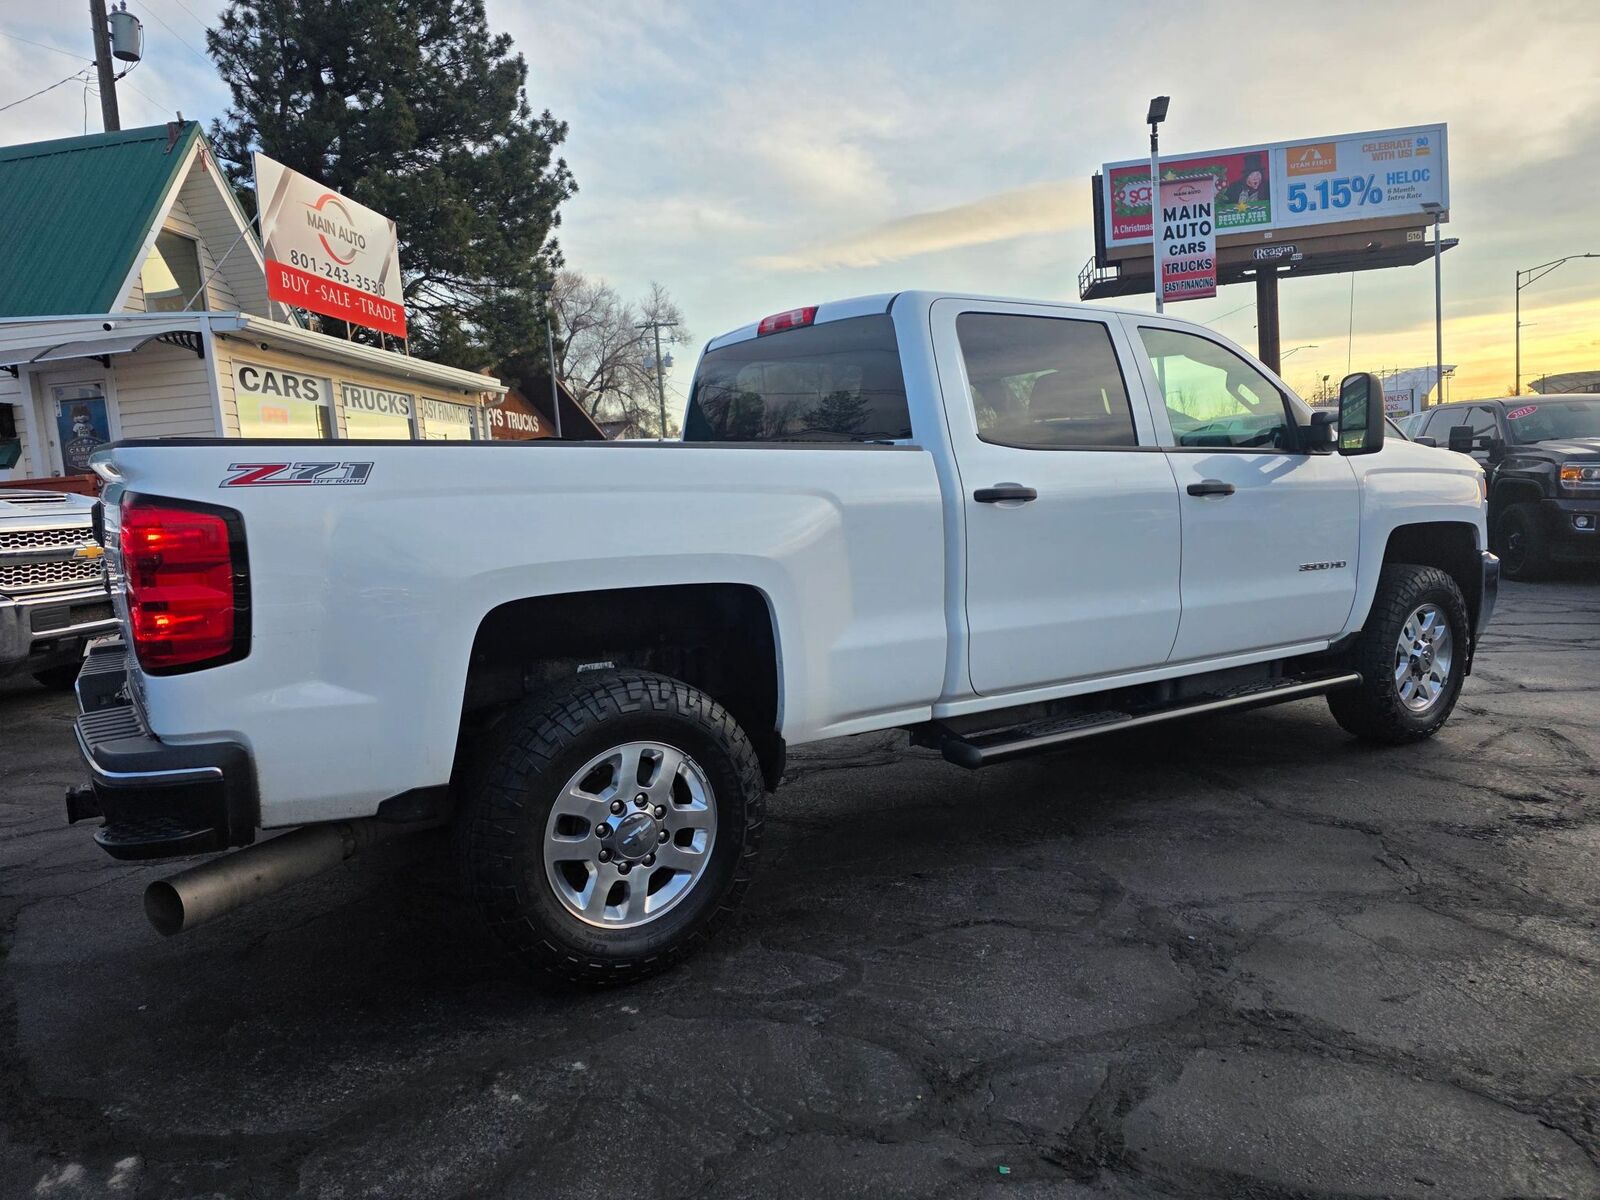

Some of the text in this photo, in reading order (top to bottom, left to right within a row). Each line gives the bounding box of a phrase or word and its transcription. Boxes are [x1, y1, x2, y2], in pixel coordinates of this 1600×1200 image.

[1362, 138, 1412, 152] CELEBRATE
[1290, 158, 1332, 169] UTAH FIRST
[1372, 150, 1394, 161] WITH
[1386, 168, 1430, 185] HELOC
[1287, 173, 1383, 214] 5.15%
[1387, 192, 1423, 201] Intro Rate
[1393, 185, 1416, 194] Month
[1163, 202, 1211, 222] MAIN
[1218, 213, 1246, 223] DESERT
[306, 210, 366, 250] MAIN AUTO
[1114, 223, 1154, 235] A Christmas
[1163, 220, 1212, 241] AUTO
[1408, 231, 1421, 241] 516
[1169, 241, 1207, 256] CARS
[1256, 245, 1295, 260] Reagan
[290, 249, 386, 297] 801-243-3530
[1164, 258, 1213, 275] TRUCKS
[281, 270, 311, 295] BUY
[1164, 277, 1214, 292] EASY FINANCING
[238, 366, 320, 402] CARS
[342, 386, 410, 416] TRUCKS
[437, 402, 474, 425] FINANCING
[505, 410, 540, 433] TRUCKS
[219, 461, 375, 489] Z71
[1330, 559, 1347, 569] HD
